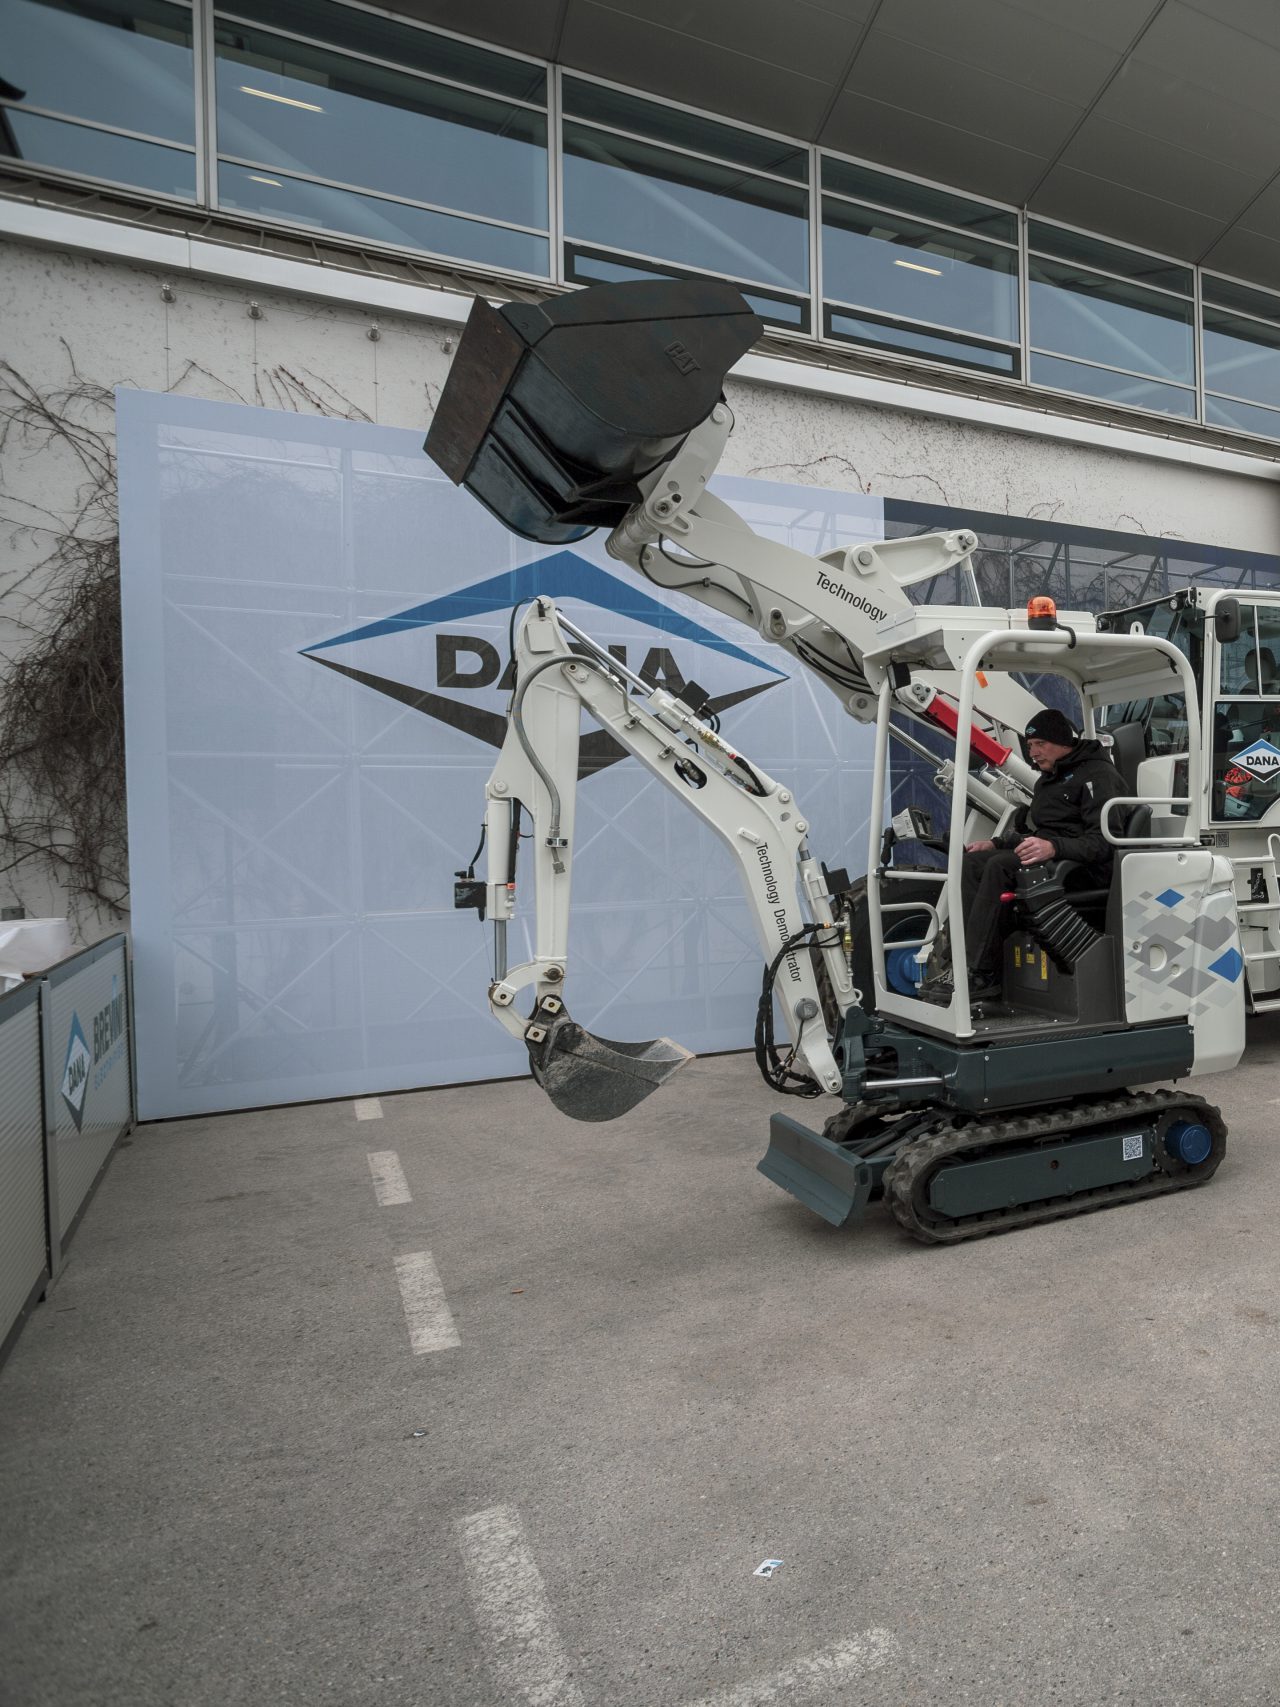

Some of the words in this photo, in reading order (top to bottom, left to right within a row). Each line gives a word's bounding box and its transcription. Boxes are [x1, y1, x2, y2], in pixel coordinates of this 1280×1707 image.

[664, 341, 700, 376] CAT
[816, 571, 888, 623] Technology
[436, 634, 690, 698] DA
[1246, 756, 1279, 766] DANA
[757, 842, 781, 904] Technology
[774, 909, 802, 982] Demotrator
[69, 1053, 86, 1096] DANA
